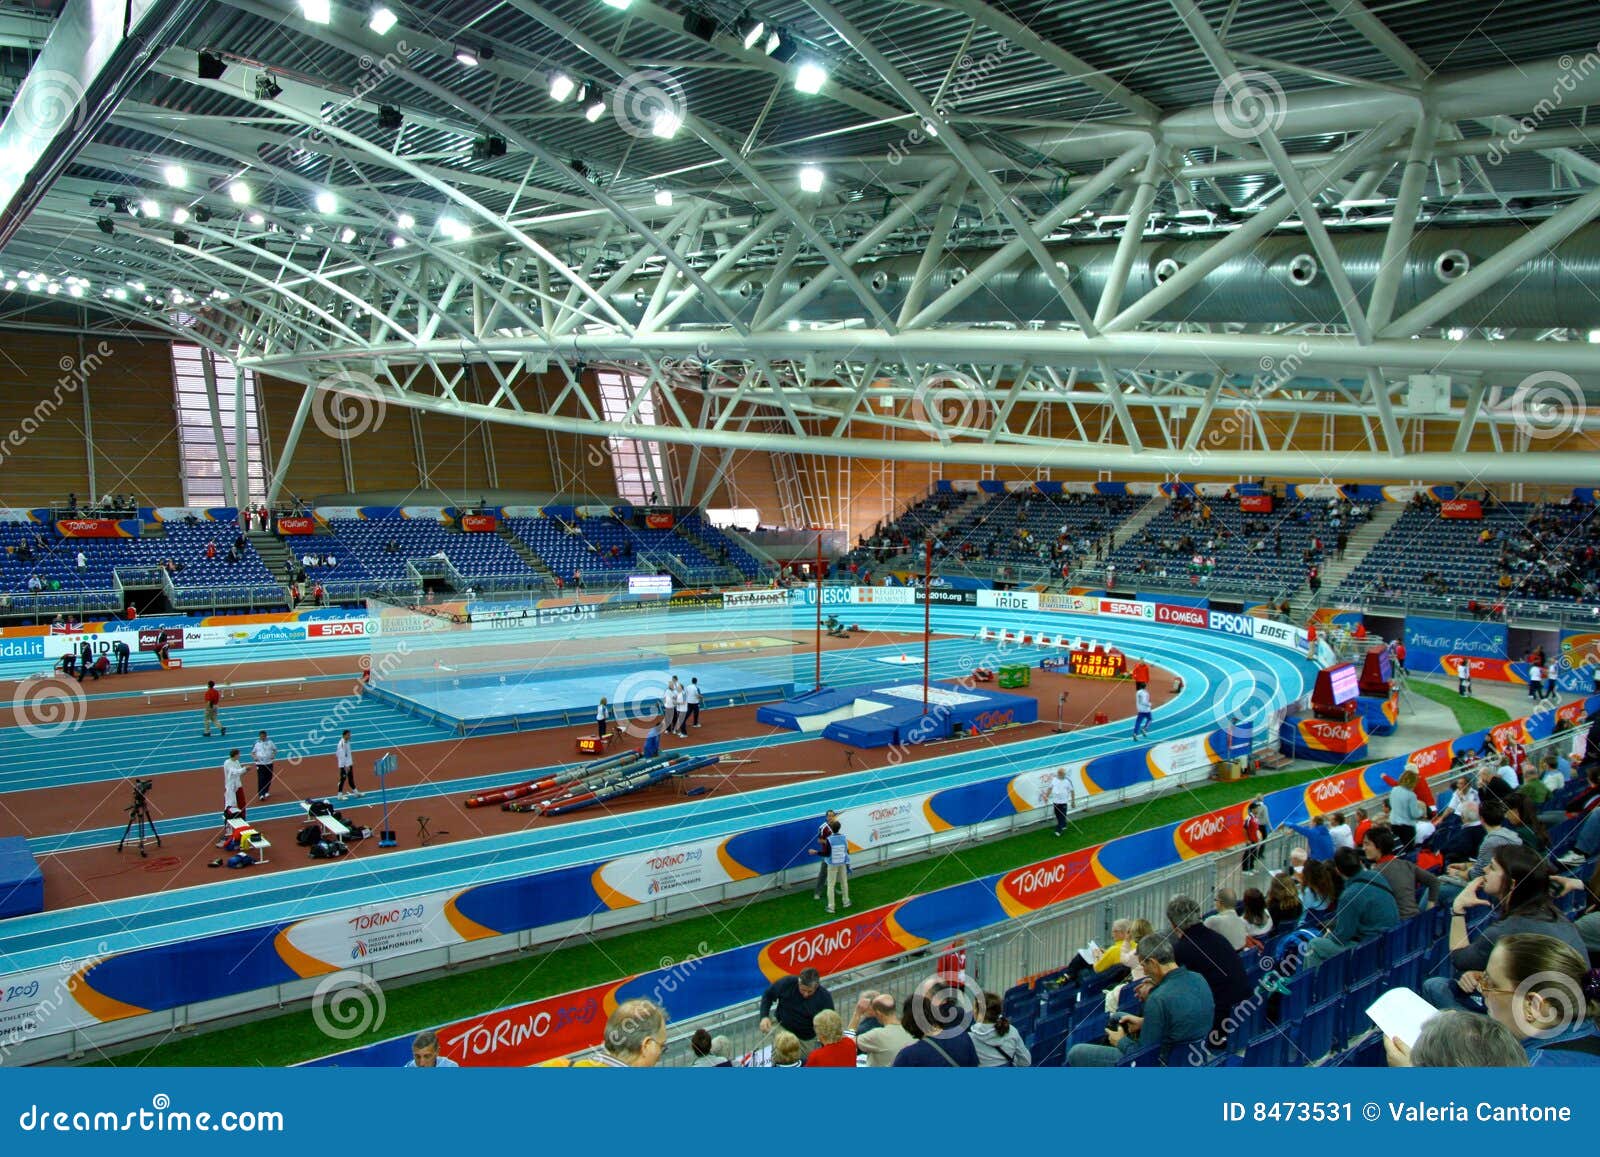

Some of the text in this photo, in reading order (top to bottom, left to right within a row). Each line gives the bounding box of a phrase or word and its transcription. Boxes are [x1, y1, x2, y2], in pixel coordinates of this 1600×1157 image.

[995, 597, 1028, 609] IRIDE
[1110, 602, 1142, 615] SPAR
[1171, 611, 1204, 625] OMEGA
[1209, 612, 1253, 636] EPSON
[321, 624, 363, 635] SPAR
[1259, 624, 1289, 640] BOSE
[0, 643, 44, 657] idal.it
[73, 640, 121, 655] IID
[1071, 654, 1122, 666] 14:39:57
[1312, 779, 1345, 801] TORINO
[1185, 816, 1224, 842] TORINO
[646, 853, 685, 870] TORINO
[1011, 864, 1065, 896] TORINO
[348, 909, 400, 931] TORINO
[368, 937, 423, 954] CHAMPIONSHIPS
[779, 927, 852, 967] TORINO
[6, 980, 40, 1003] 2009
[447, 1011, 552, 1060] TORINO
